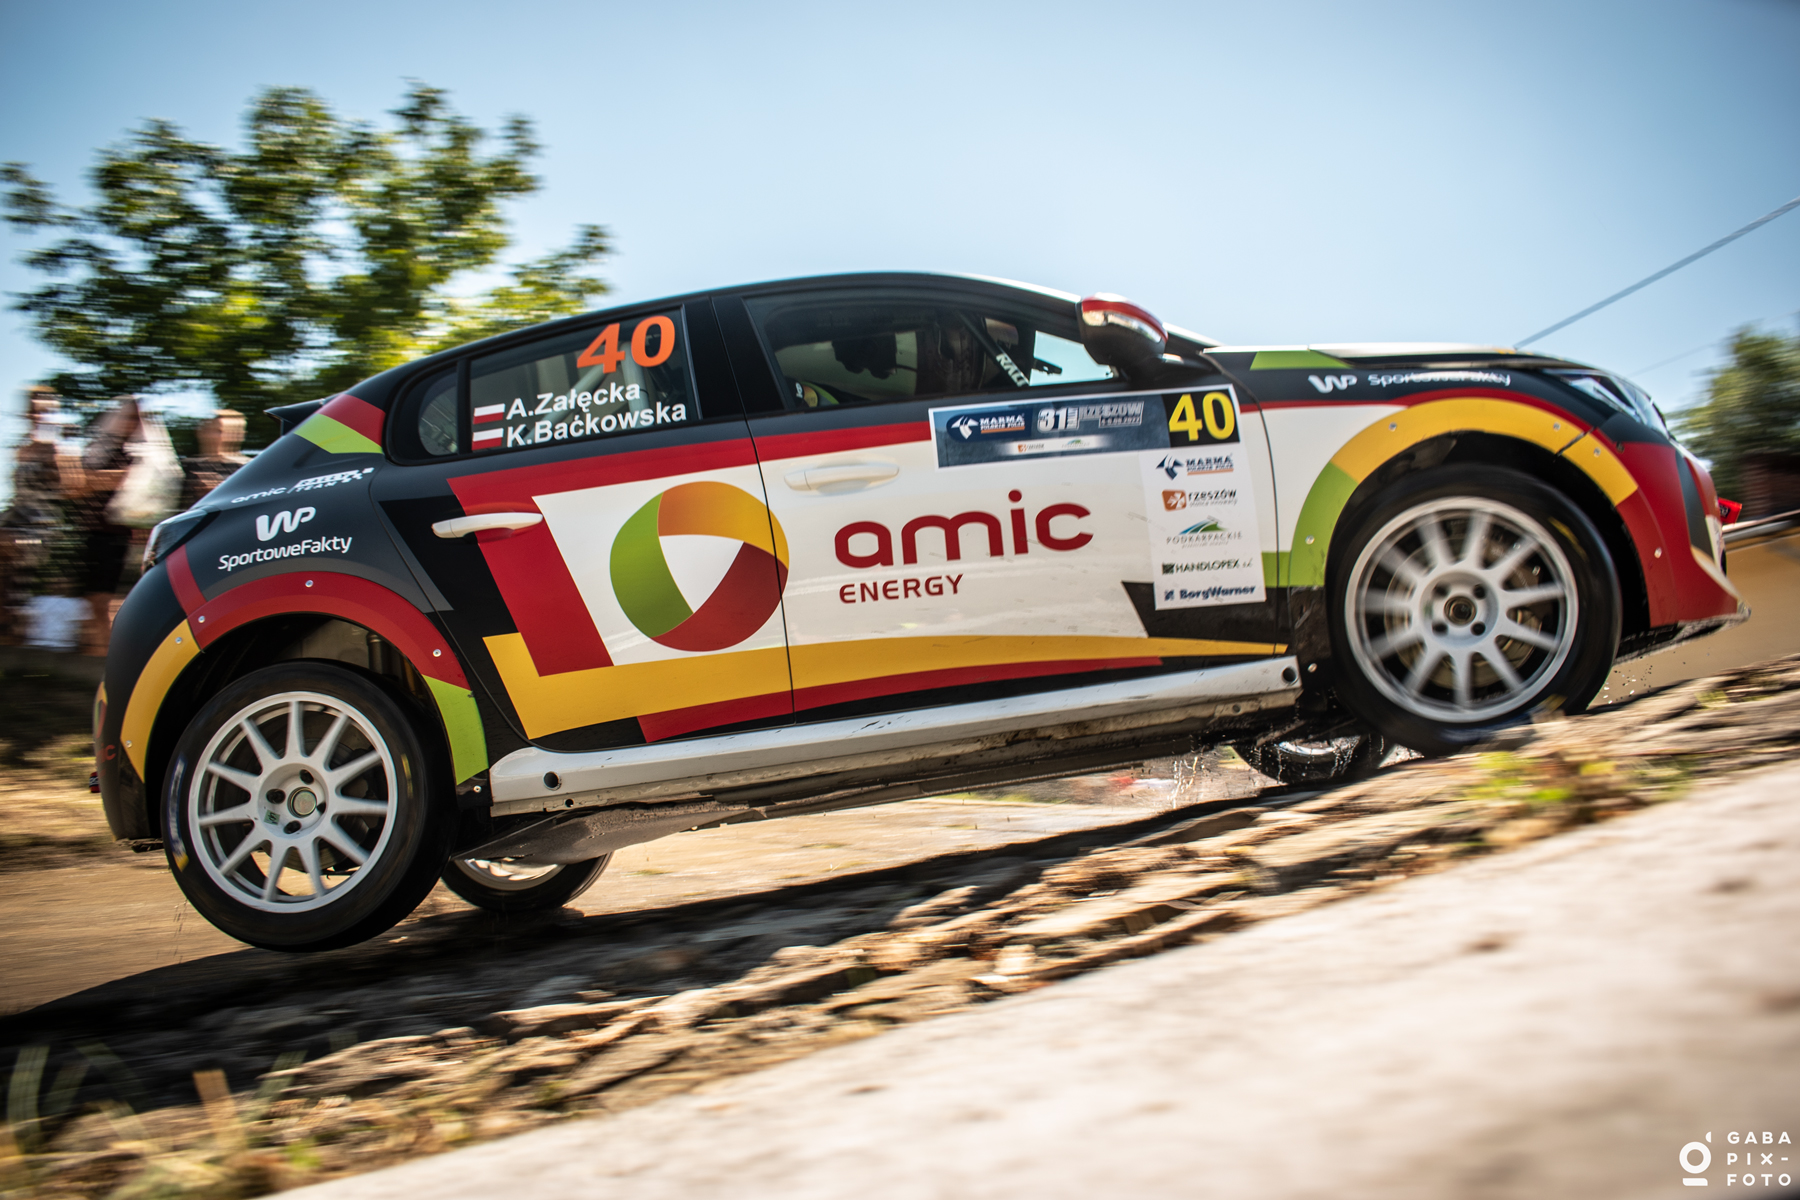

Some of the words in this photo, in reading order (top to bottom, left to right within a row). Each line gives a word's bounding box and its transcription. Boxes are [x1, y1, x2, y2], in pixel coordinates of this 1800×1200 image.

[576, 315, 676, 374] 40
[1308, 374, 1358, 394] WP
[506, 382, 641, 420] A.Załęcka
[1168, 391, 1236, 441] 40
[980, 414, 1025, 426] MARMA
[1186, 455, 1234, 467] MARMA
[256, 506, 316, 541] WP
[835, 489, 1094, 569] amic
[1166, 531, 1243, 545] PODKARPACKIE
[218, 536, 352, 571] SportoweFakty
[1176, 558, 1240, 573] HANDLOPEX
[839, 574, 964, 604] ENERGY
[1180, 586, 1256, 600] BorgWarner
